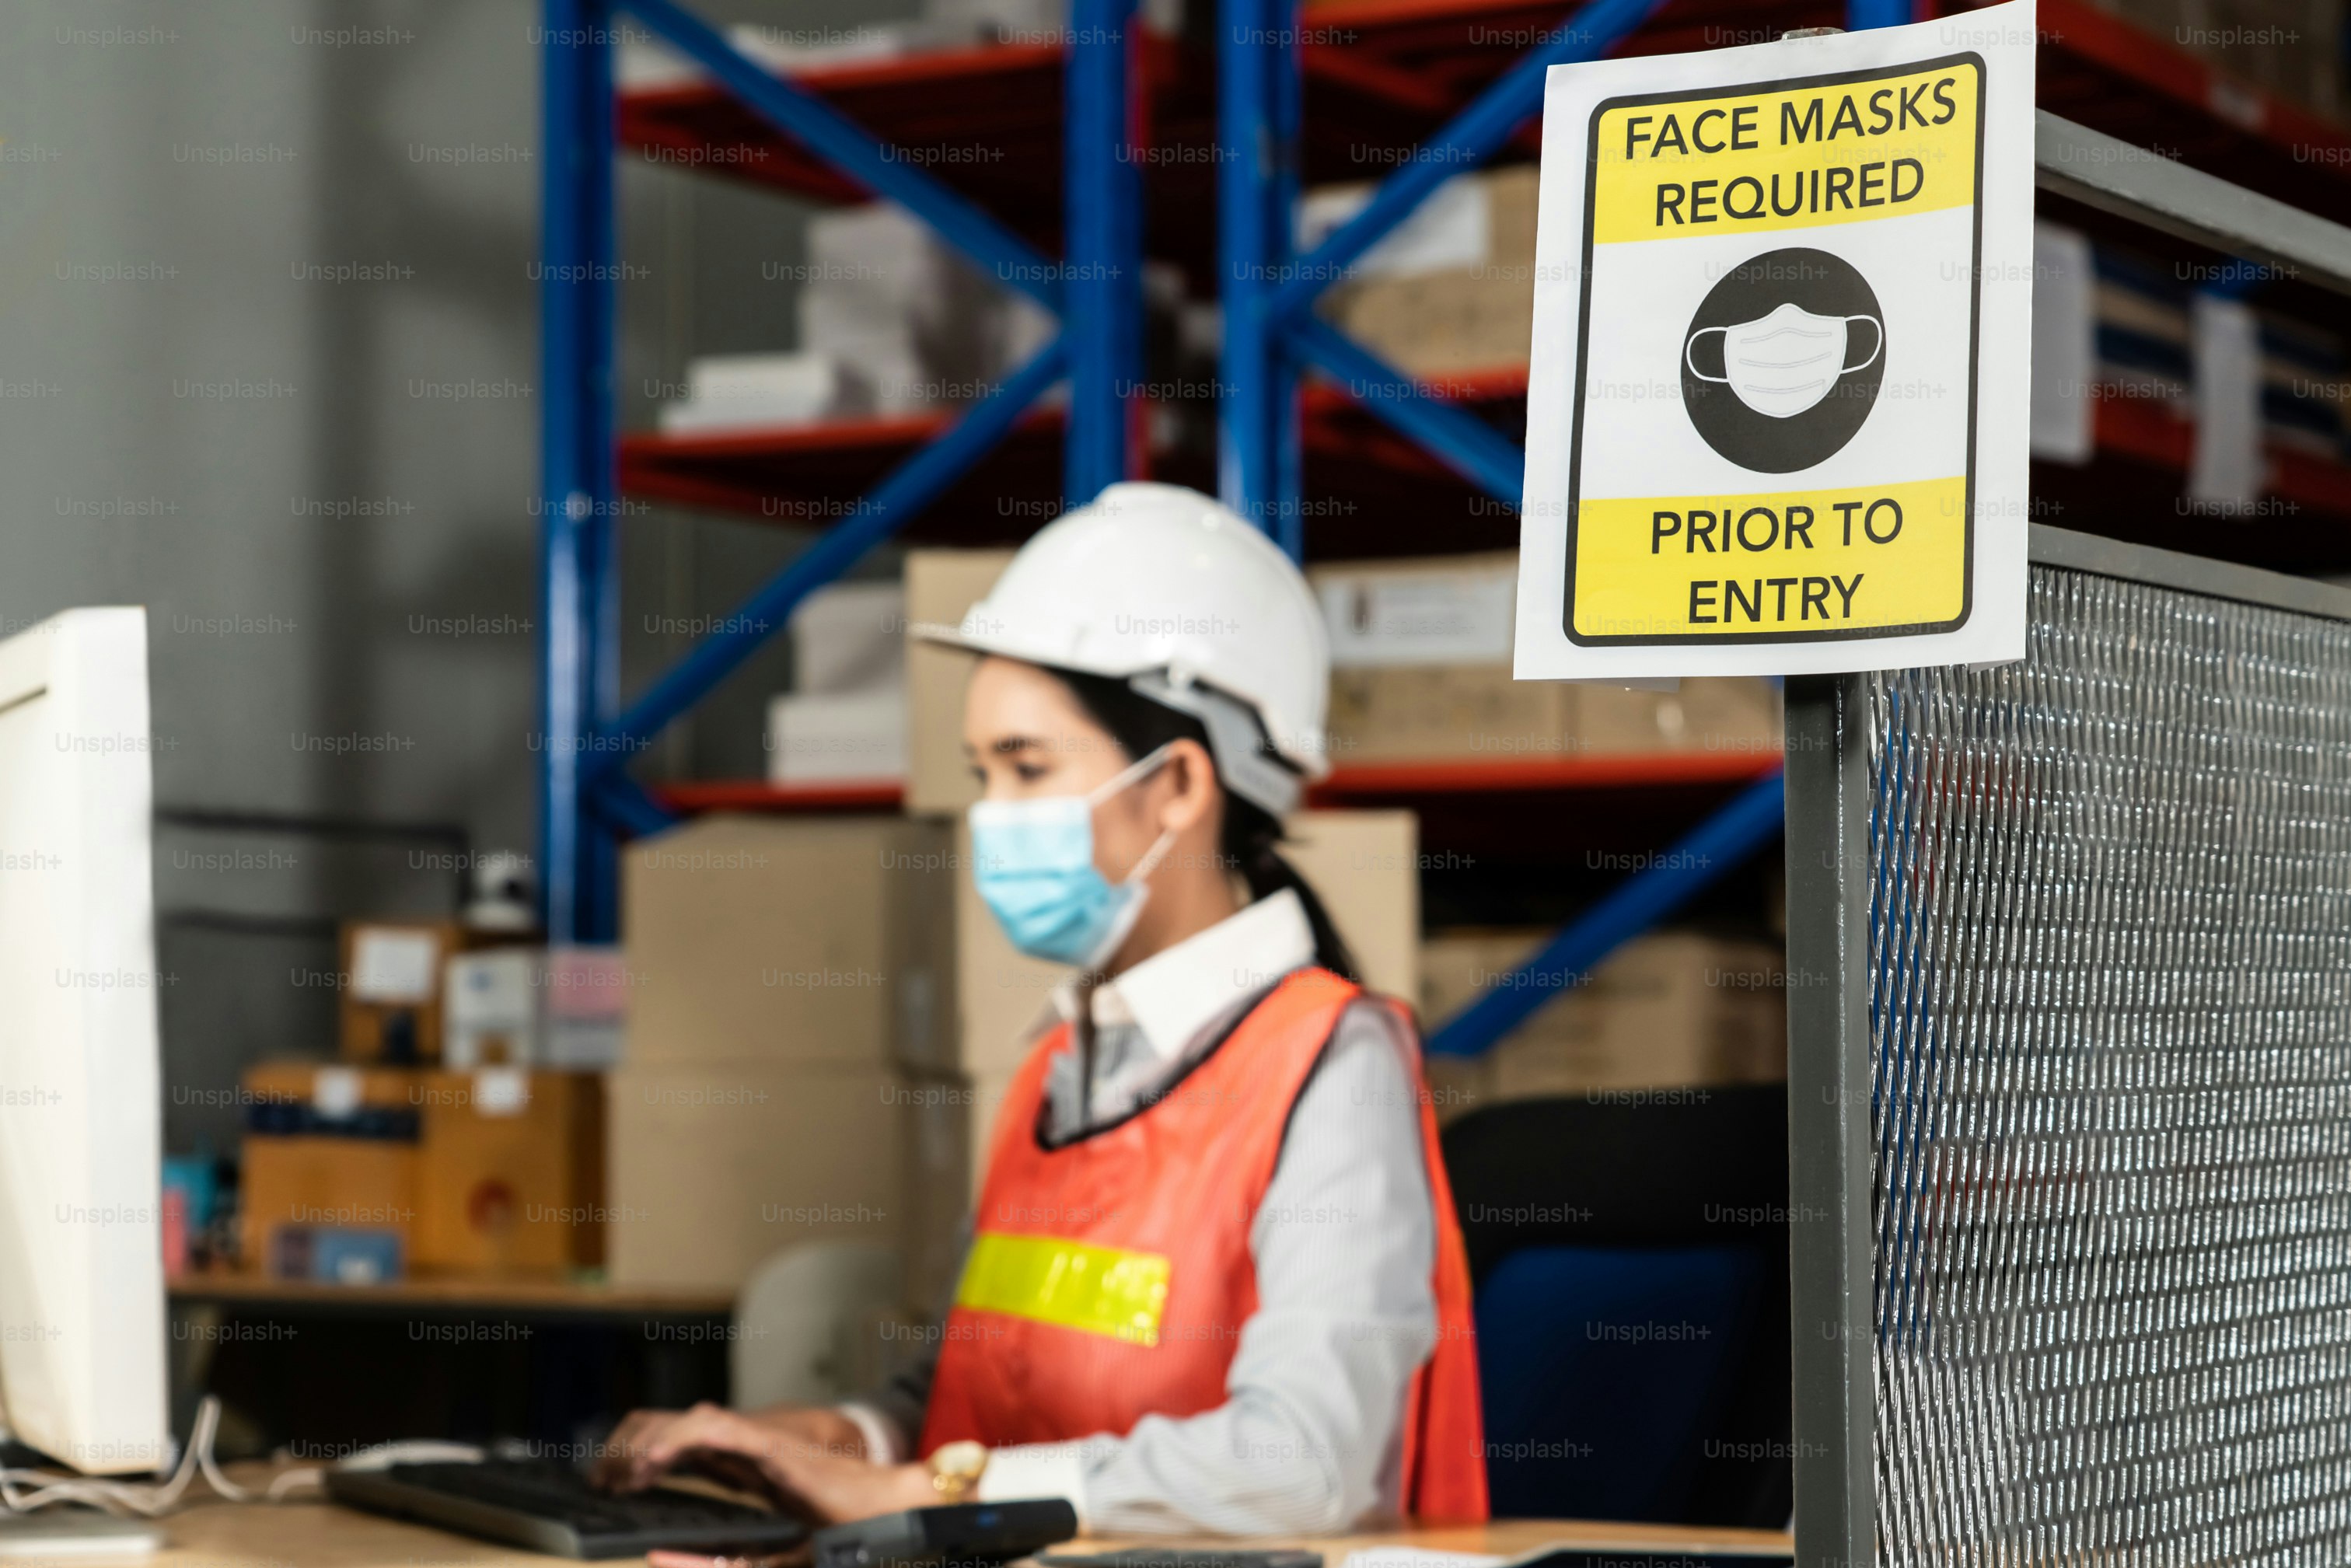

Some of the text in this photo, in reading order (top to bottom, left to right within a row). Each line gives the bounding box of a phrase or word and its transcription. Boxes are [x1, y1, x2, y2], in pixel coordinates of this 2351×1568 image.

[1626, 78, 1956, 160] FACE MASKS
[1655, 158, 1924, 226] REQUIRED
[1651, 498, 1903, 554] PRIOR TO
[1689, 573, 1864, 623] ENTRY
